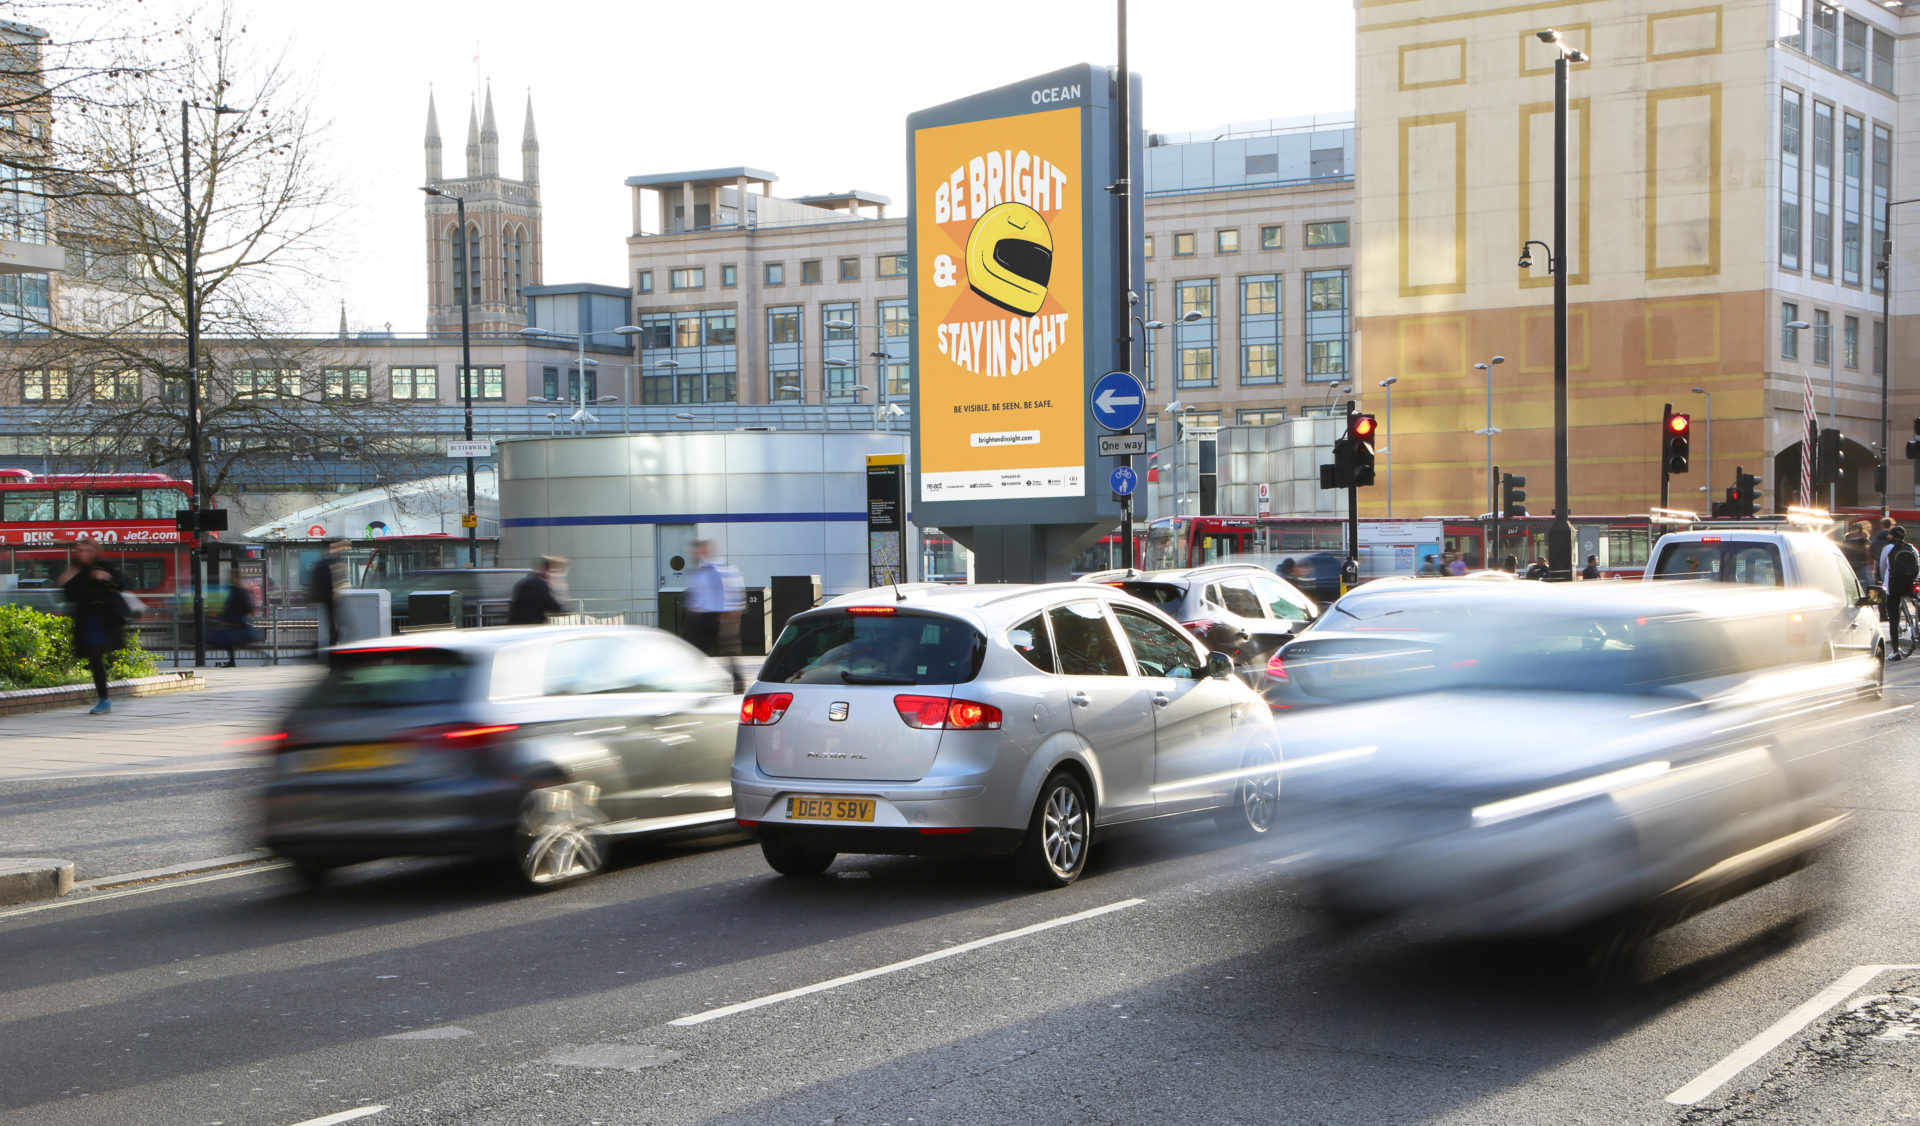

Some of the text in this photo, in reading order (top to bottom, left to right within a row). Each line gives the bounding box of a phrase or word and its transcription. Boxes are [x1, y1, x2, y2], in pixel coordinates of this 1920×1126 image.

[1031, 84, 1081, 105] OCEAN
[935, 150, 1067, 224] BE BRIGHT
[933, 254, 957, 288] &
[937, 312, 1069, 377] STAY IN SIGHT
[953, 399, 1054, 413] BE VISIBLE. BE SEEN. BE SAFE.
[978, 434, 1033, 444] brightandinsight.com
[1101, 440, 1143, 451] One way
[798, 800, 869, 819] DE13 SBV
